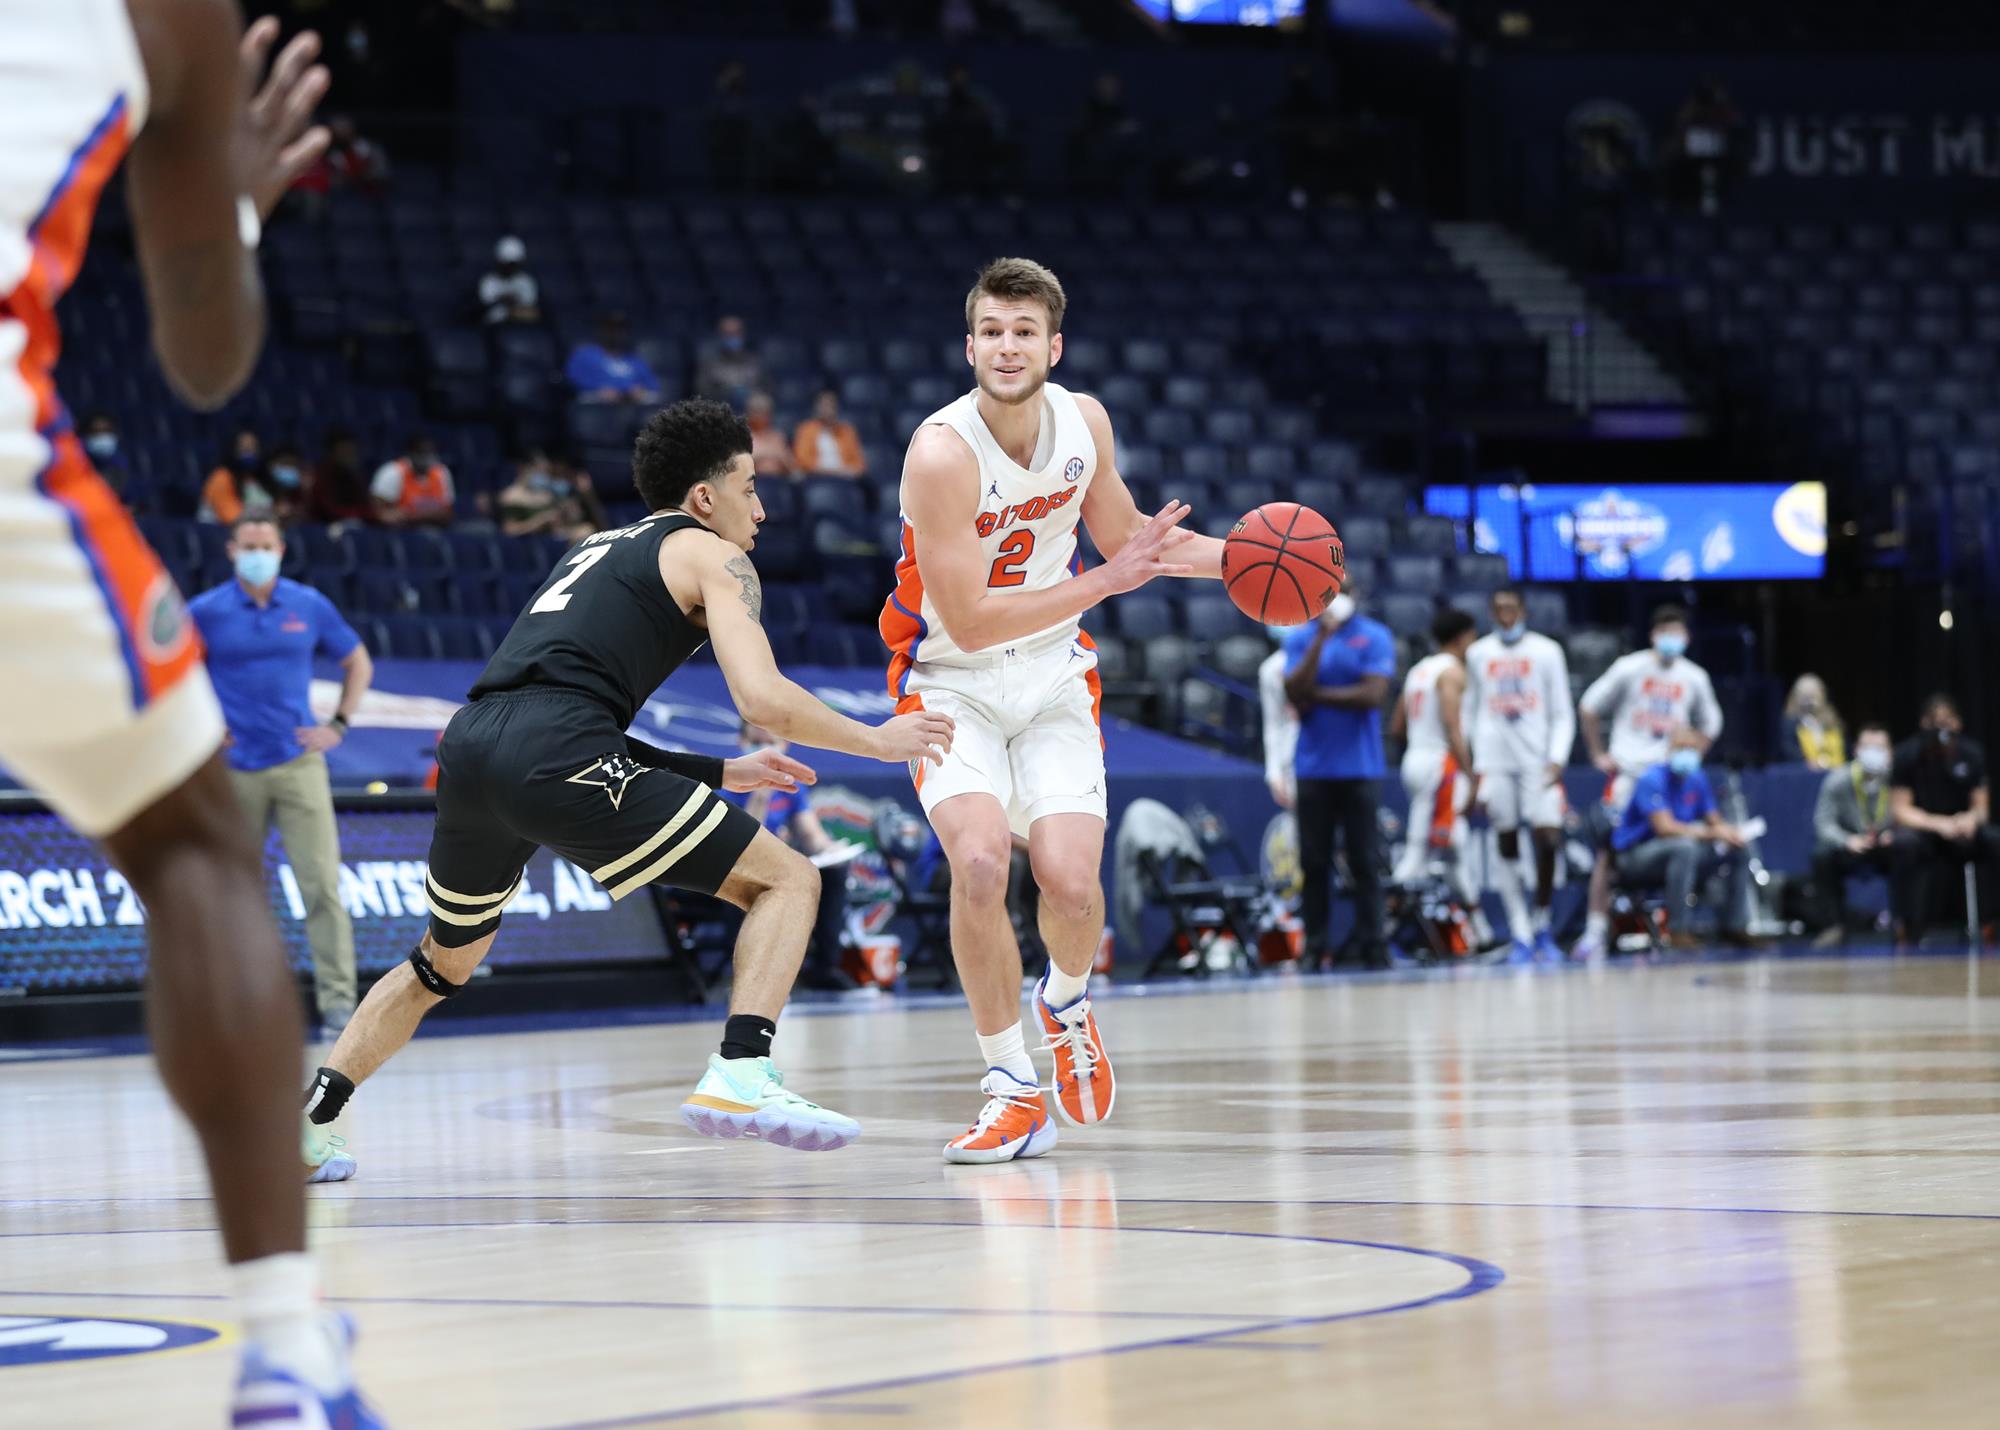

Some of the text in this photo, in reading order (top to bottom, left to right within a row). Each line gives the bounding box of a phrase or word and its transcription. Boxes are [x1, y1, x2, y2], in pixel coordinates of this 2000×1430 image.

[1750, 113, 2000, 178] JUST M
[529, 543, 612, 615] 2
[988, 528, 1035, 588] 2
[0, 868, 107, 929] RCH
